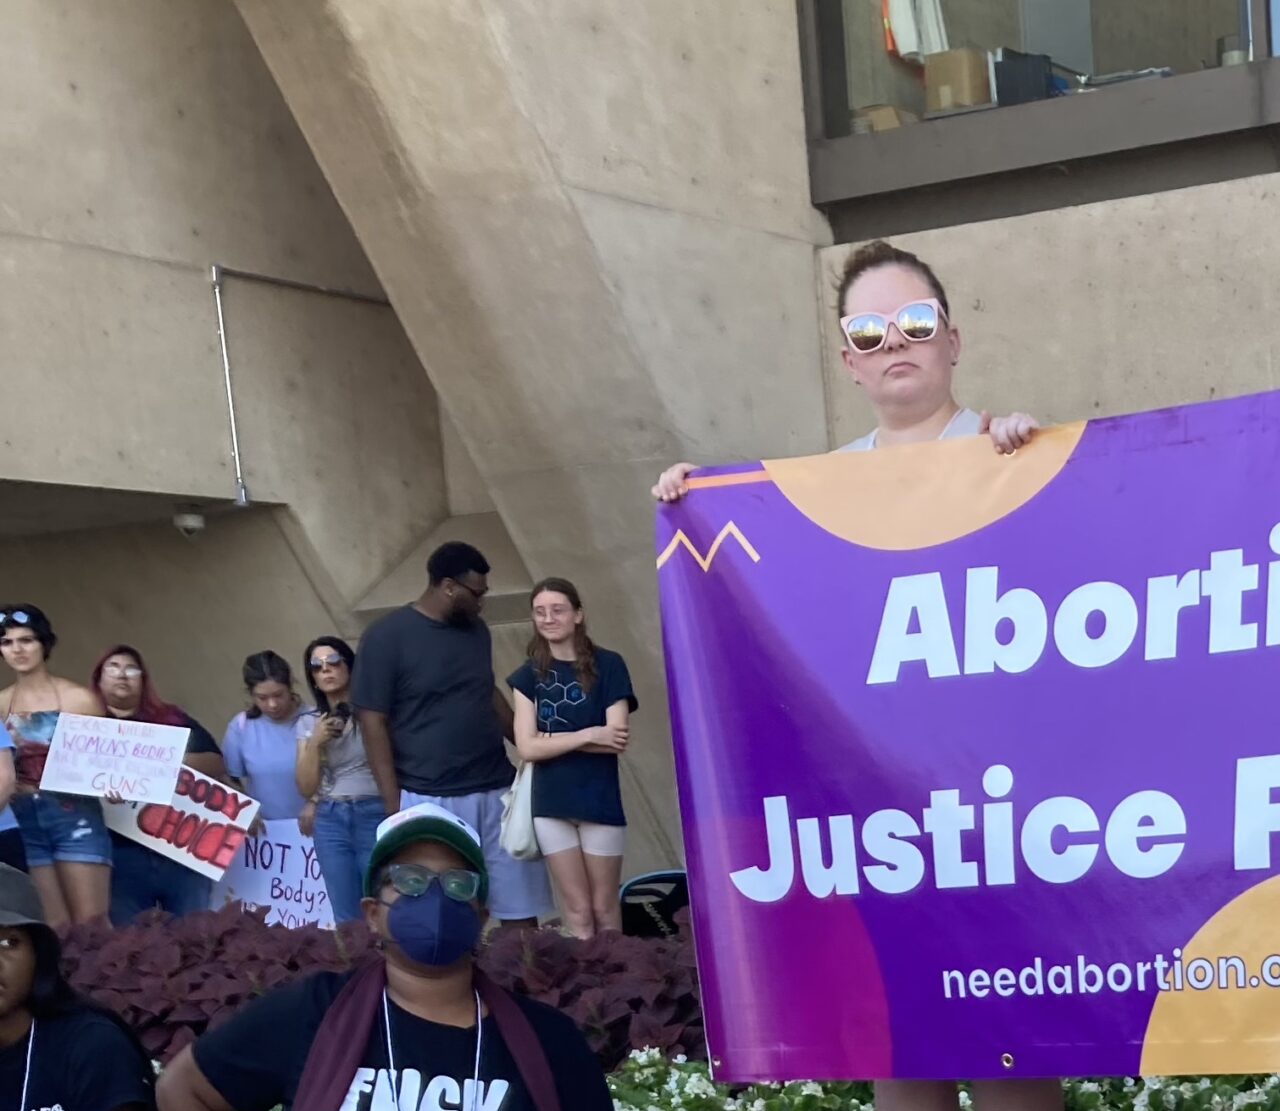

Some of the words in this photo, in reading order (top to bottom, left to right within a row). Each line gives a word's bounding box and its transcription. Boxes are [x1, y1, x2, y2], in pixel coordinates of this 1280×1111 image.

[132, 742, 176, 762] BODIES
[91, 772, 151, 797] GUNS
[175, 769, 252, 821] BODY
[137, 803, 246, 870] CHOICE
[729, 764, 1187, 902] Justice
[244, 836, 291, 873] NOT
[301, 845, 321, 880] YO
[270, 877, 327, 913] Body?
